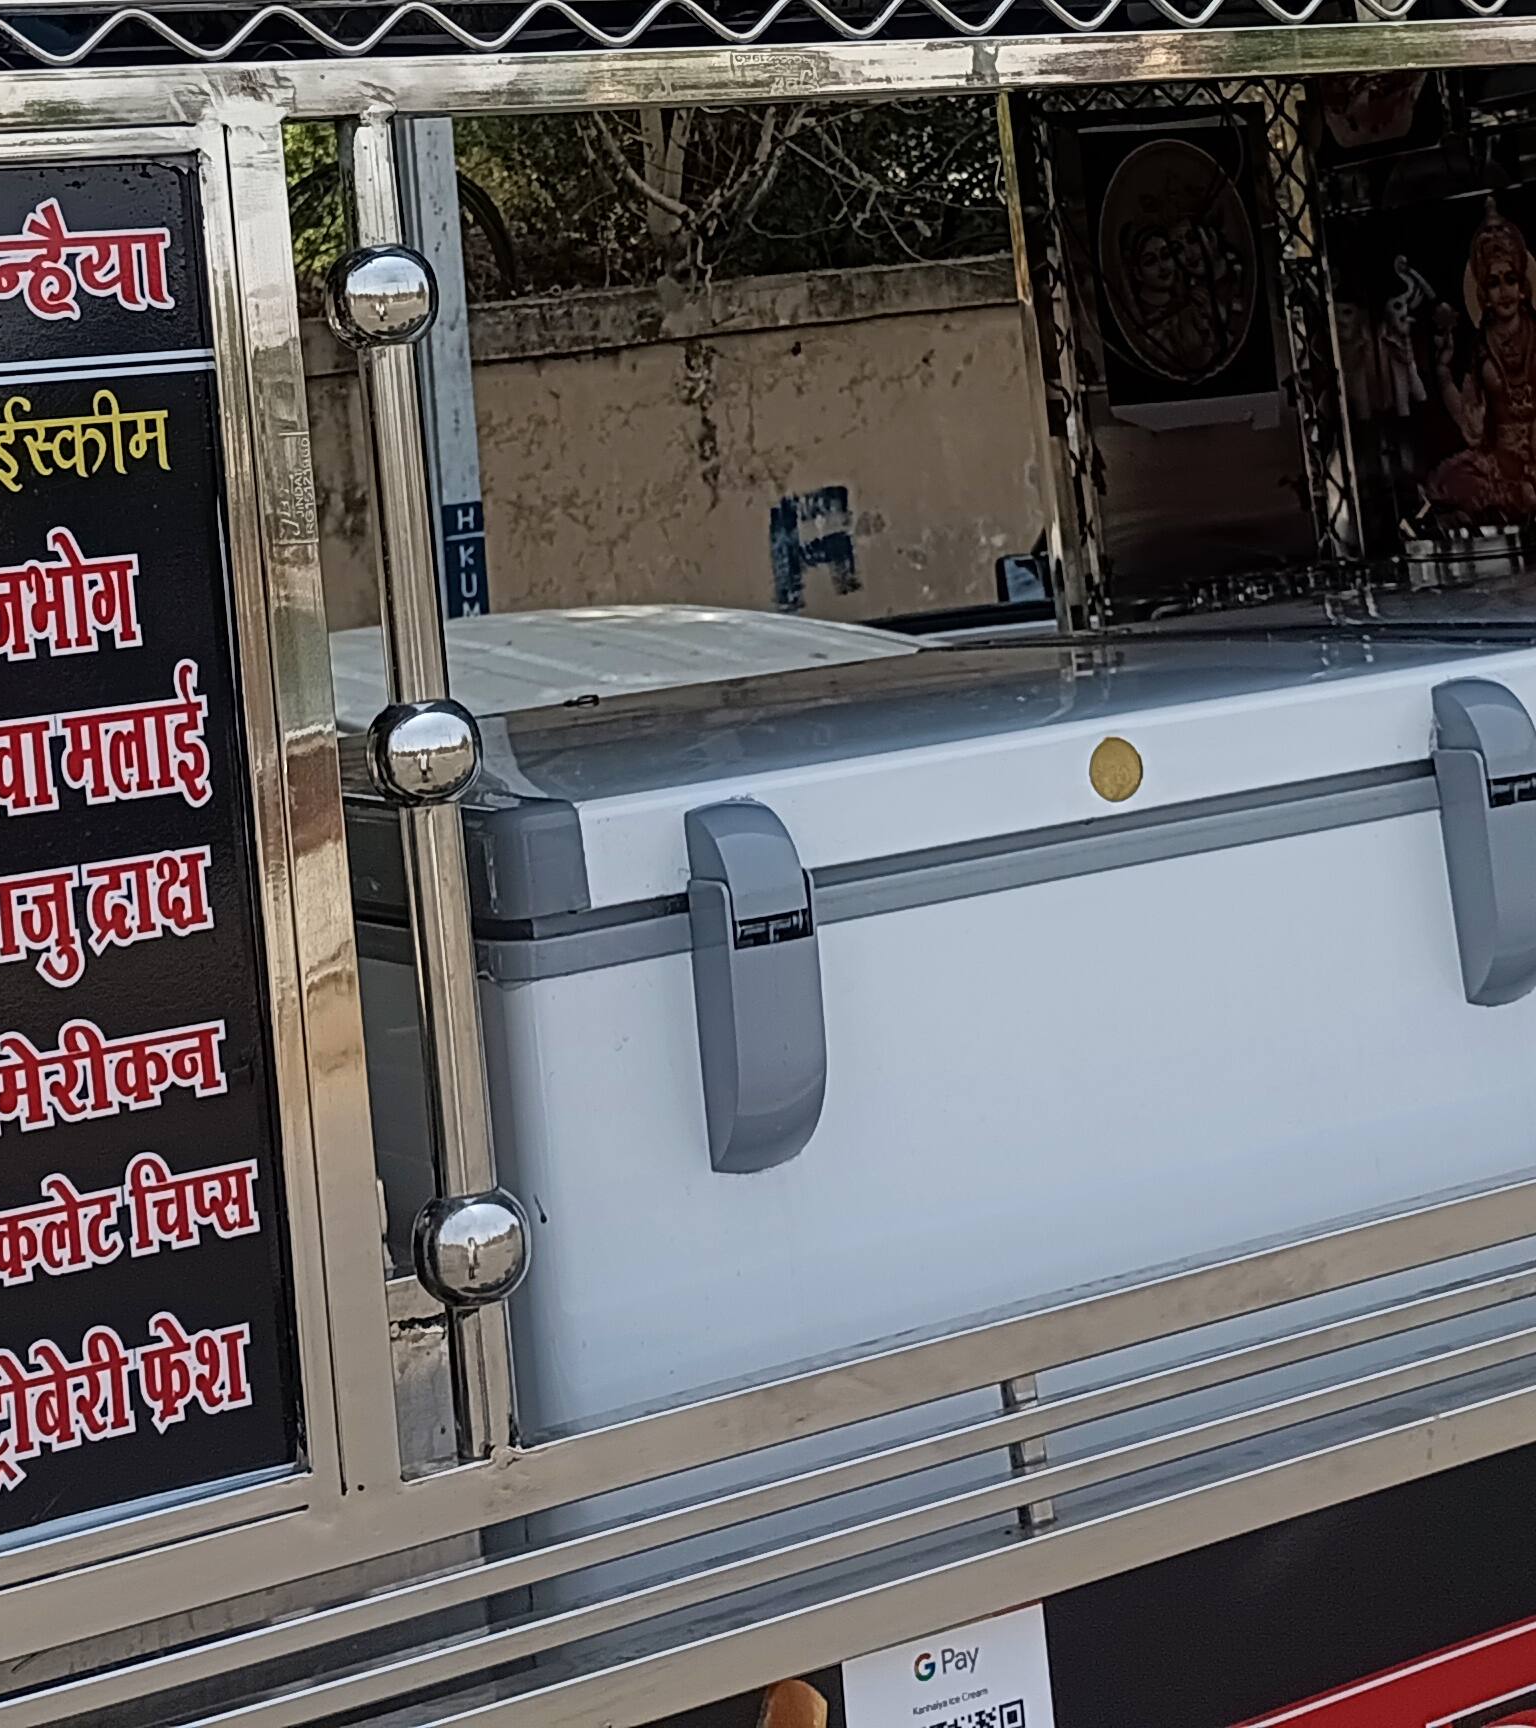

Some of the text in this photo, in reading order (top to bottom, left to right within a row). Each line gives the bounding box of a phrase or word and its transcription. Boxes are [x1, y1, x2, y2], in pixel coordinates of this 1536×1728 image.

[62, 658, 213, 808] मलाई
[85, 845, 213, 956] द्राक्ष
[126, 1151, 260, 1258] चिप्स
[137, 1311, 251, 1433] फ्रेश
[940, 1646, 980, 1675] Pay
